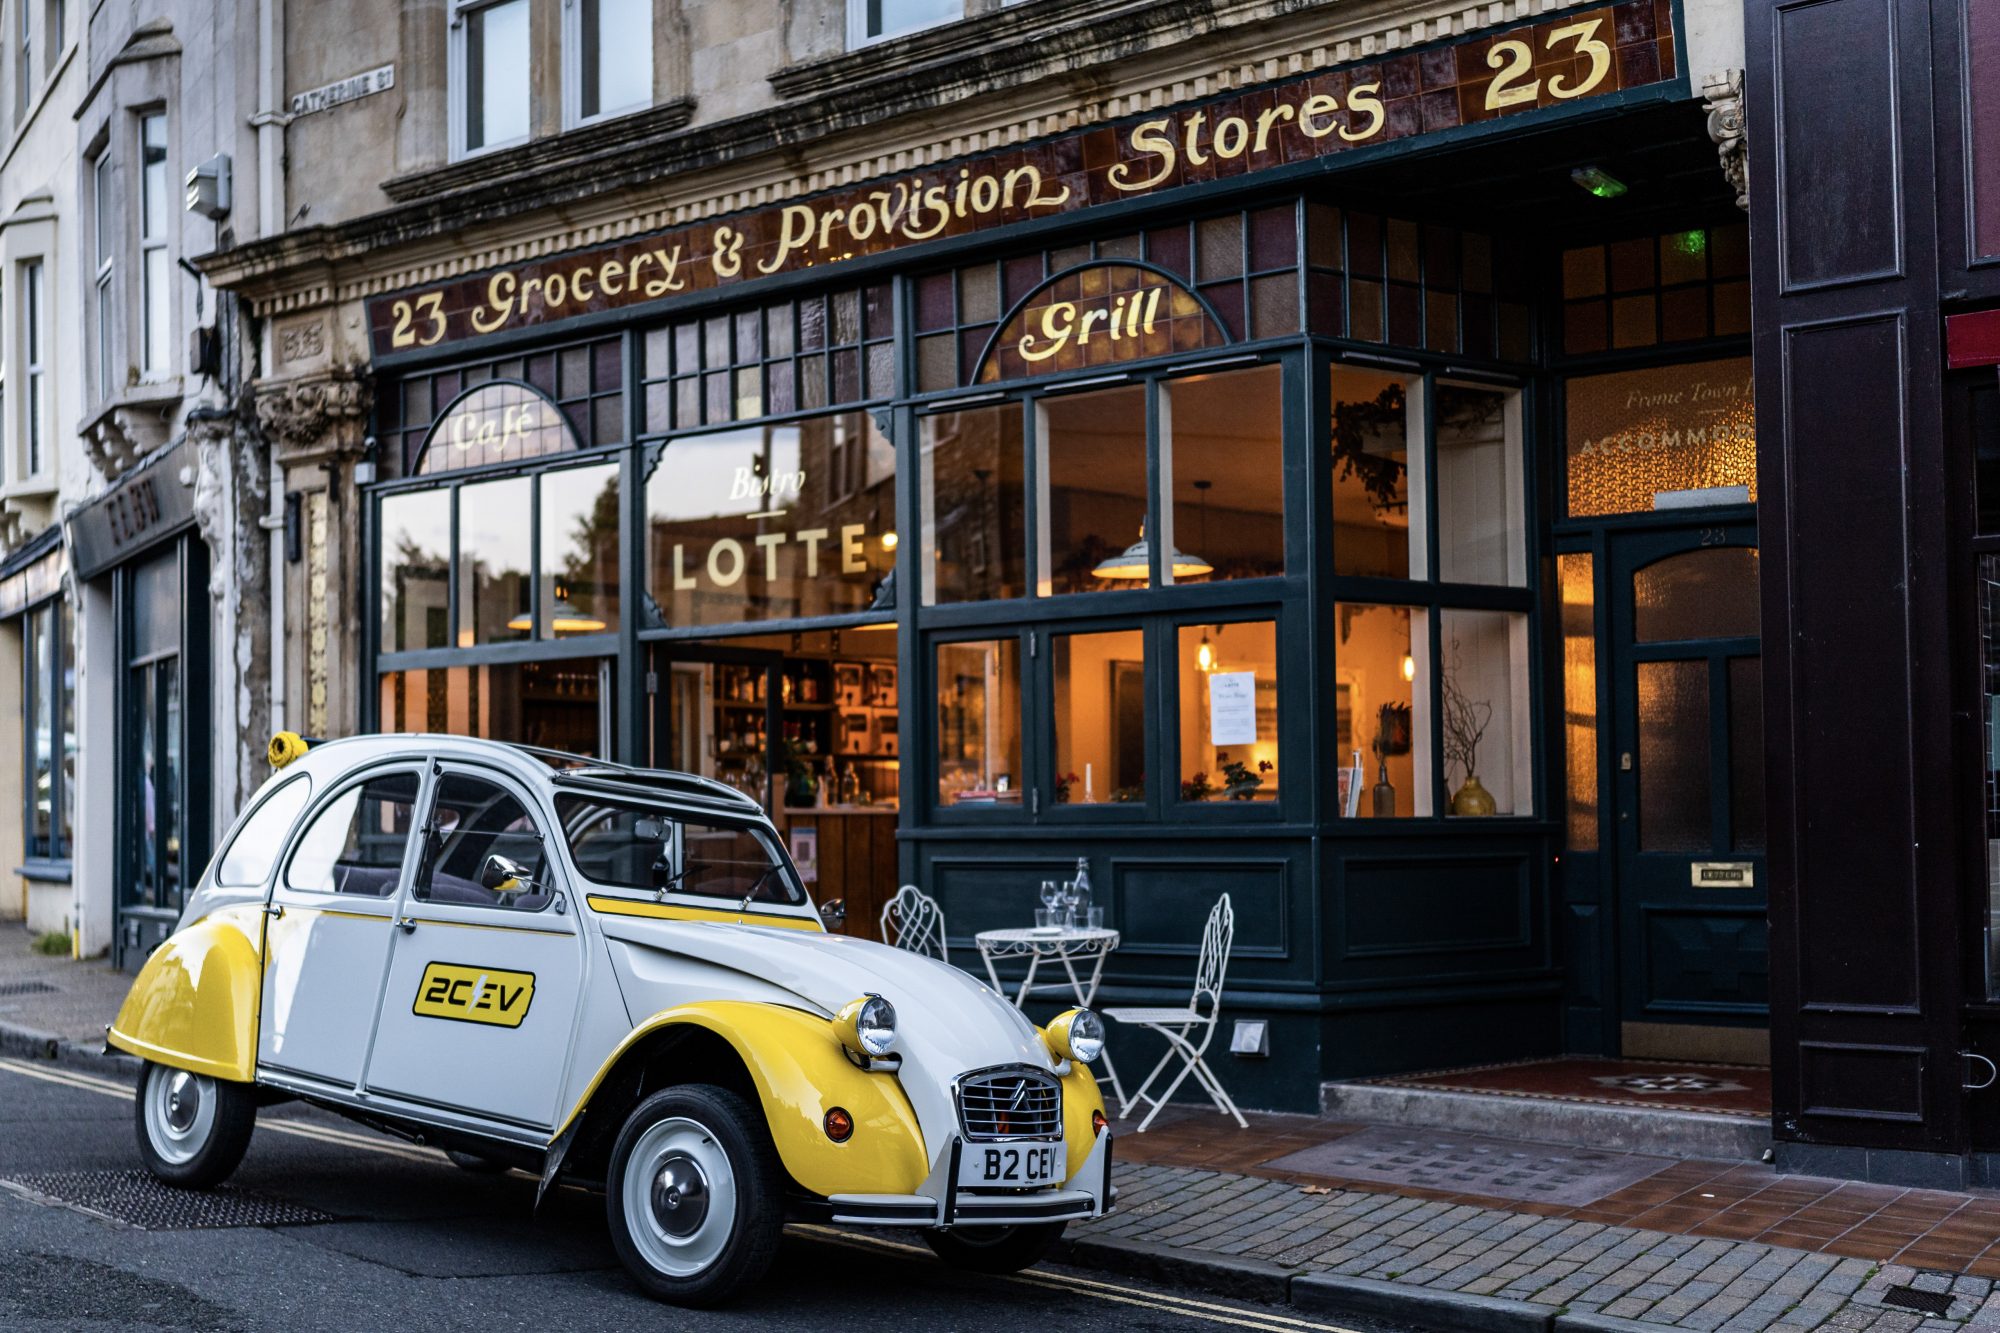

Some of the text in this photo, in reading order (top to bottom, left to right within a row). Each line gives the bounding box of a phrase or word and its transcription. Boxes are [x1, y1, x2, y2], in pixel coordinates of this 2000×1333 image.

[392, 291, 447, 348] 23
[471, 245, 684, 333] Grocery
[712, 226, 744, 278] &
[1108, 81, 1387, 191] Stores
[1485, 18, 1611, 111] 23
[1018, 287, 1162, 362] Grill
[1691, 380, 1737, 402] Town
[453, 402, 534, 453] Café
[729, 464, 806, 500] Bistro
[673, 523, 867, 591] LOTTE
[1700, 527, 1727, 546] 23
[983, 1147, 1057, 1181] B2 CEV
